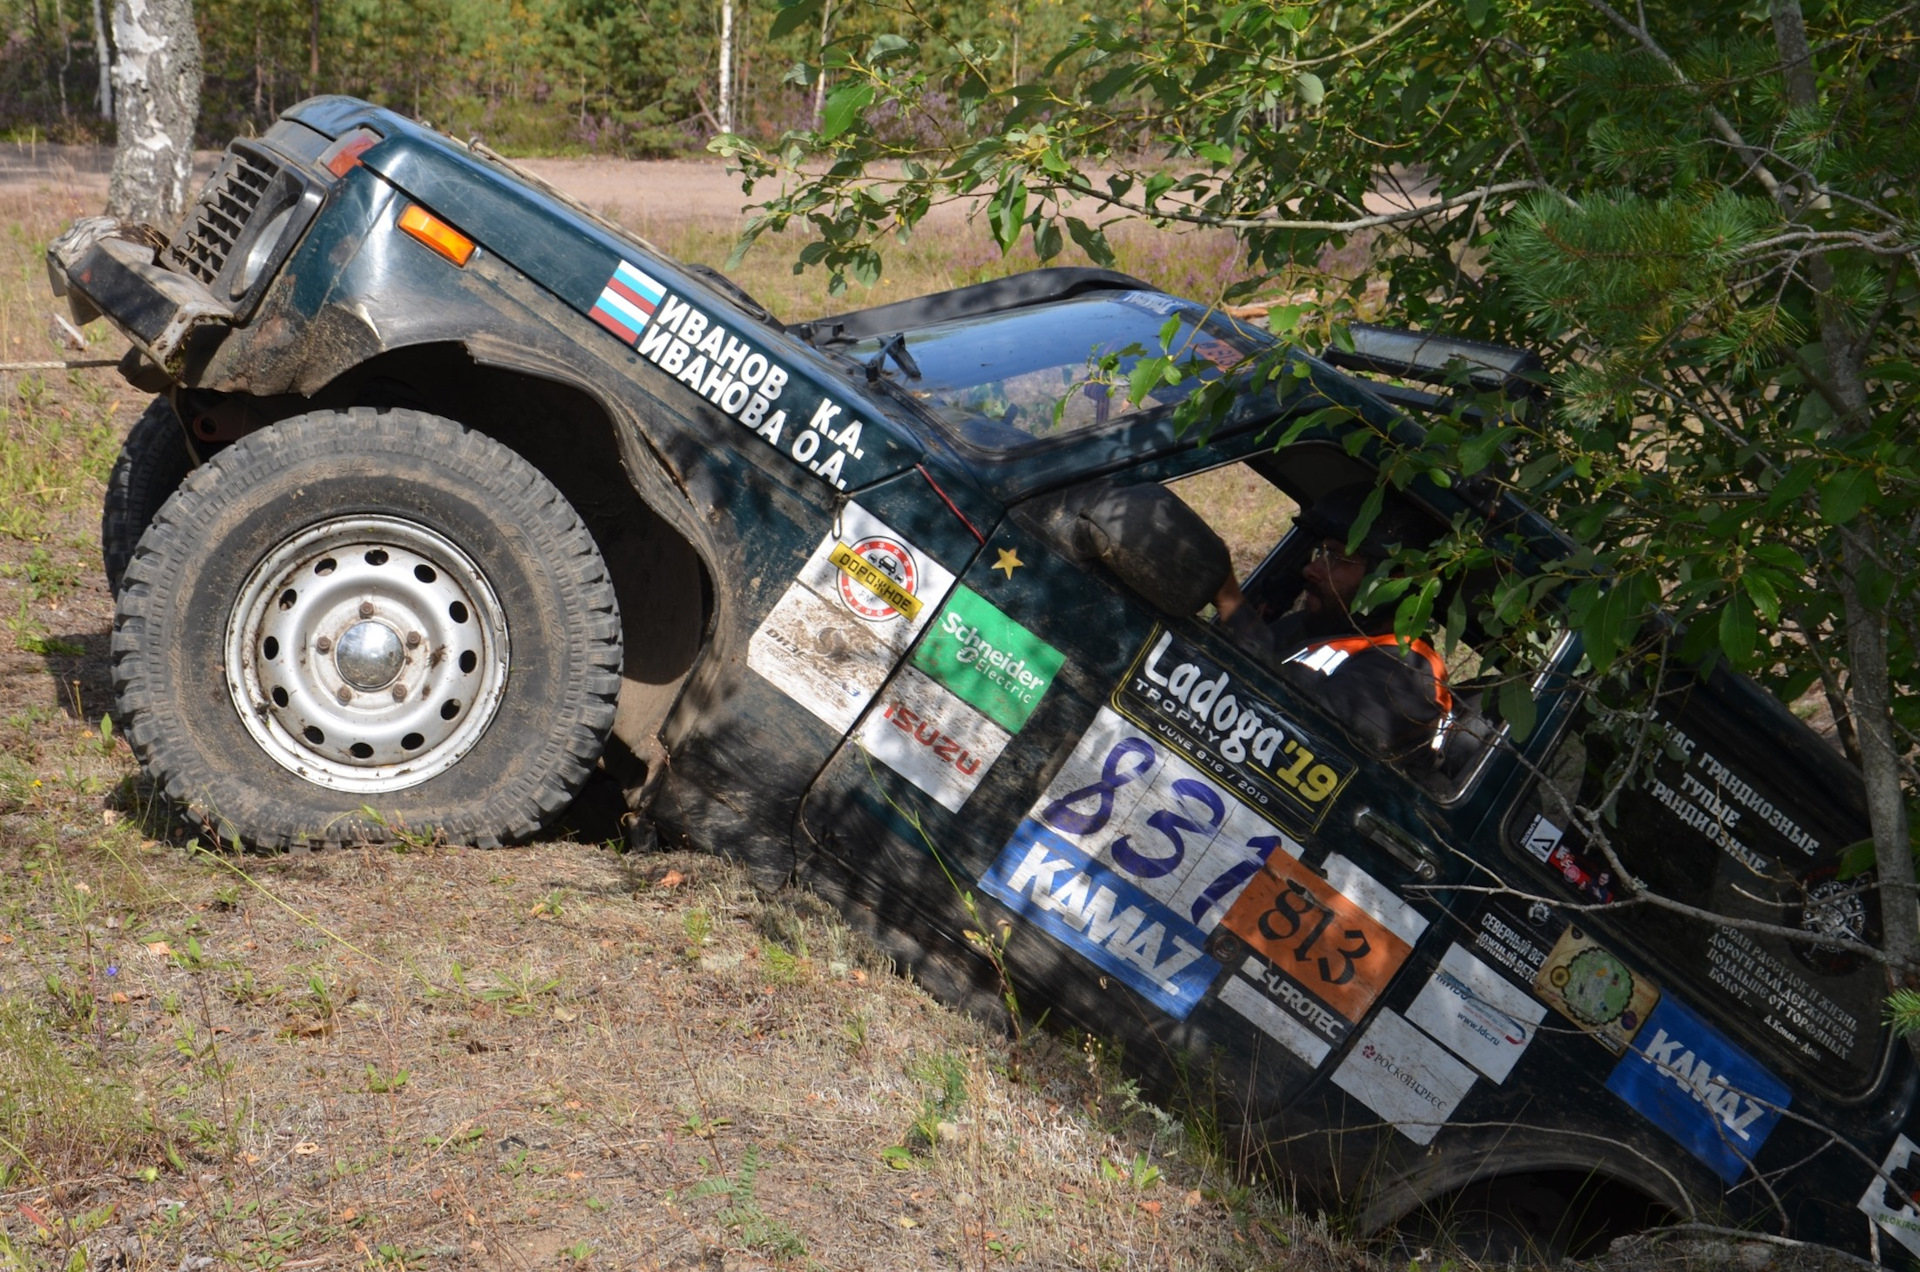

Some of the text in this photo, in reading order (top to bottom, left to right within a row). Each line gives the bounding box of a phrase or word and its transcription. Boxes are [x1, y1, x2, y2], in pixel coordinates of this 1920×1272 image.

[637, 324, 847, 490] ИВАНОВА О.А.
[657, 295, 864, 460] ИВАНОВ К.А.
[941, 611, 1044, 691] Schneider
[975, 659, 1033, 704] Electric
[883, 703, 982, 776] ISUZU
[1132, 677, 1221, 745] TROPHY
[1143, 630, 1340, 803] Ladoga '19
[1157, 722, 1194, 751] JUNE
[1196, 747, 1225, 775] 8-16
[1237, 776, 1270, 805] 2019
[1677, 771, 1741, 829] ТУПЫЕ
[1696, 751, 1820, 857] ГРАНДИОЗНЫЕ
[1007, 840, 1203, 996] KAMAZ
[1257, 877, 1372, 987] 813
[1479, 911, 1532, 956] СЕВЕРНЫЙ
[1707, 932, 1755, 972] ДОРОГИ
[1512, 959, 1539, 985] ВЕТЕ
[1705, 947, 1850, 1060] ПОДАЛЬШЕ ОТ ТОРФЯНЫХ
[1750, 945, 1810, 994] РАССУДОК
[1807, 988, 1819, 1001] И
[1817, 995, 1860, 1032] ЖИЗНЬ
[1456, 1011, 1500, 1046] www.ldc.ru
[1373, 1053, 1447, 1112] РОСКОНГРЕСС
[1641, 1029, 1765, 1140] KAMAZ
